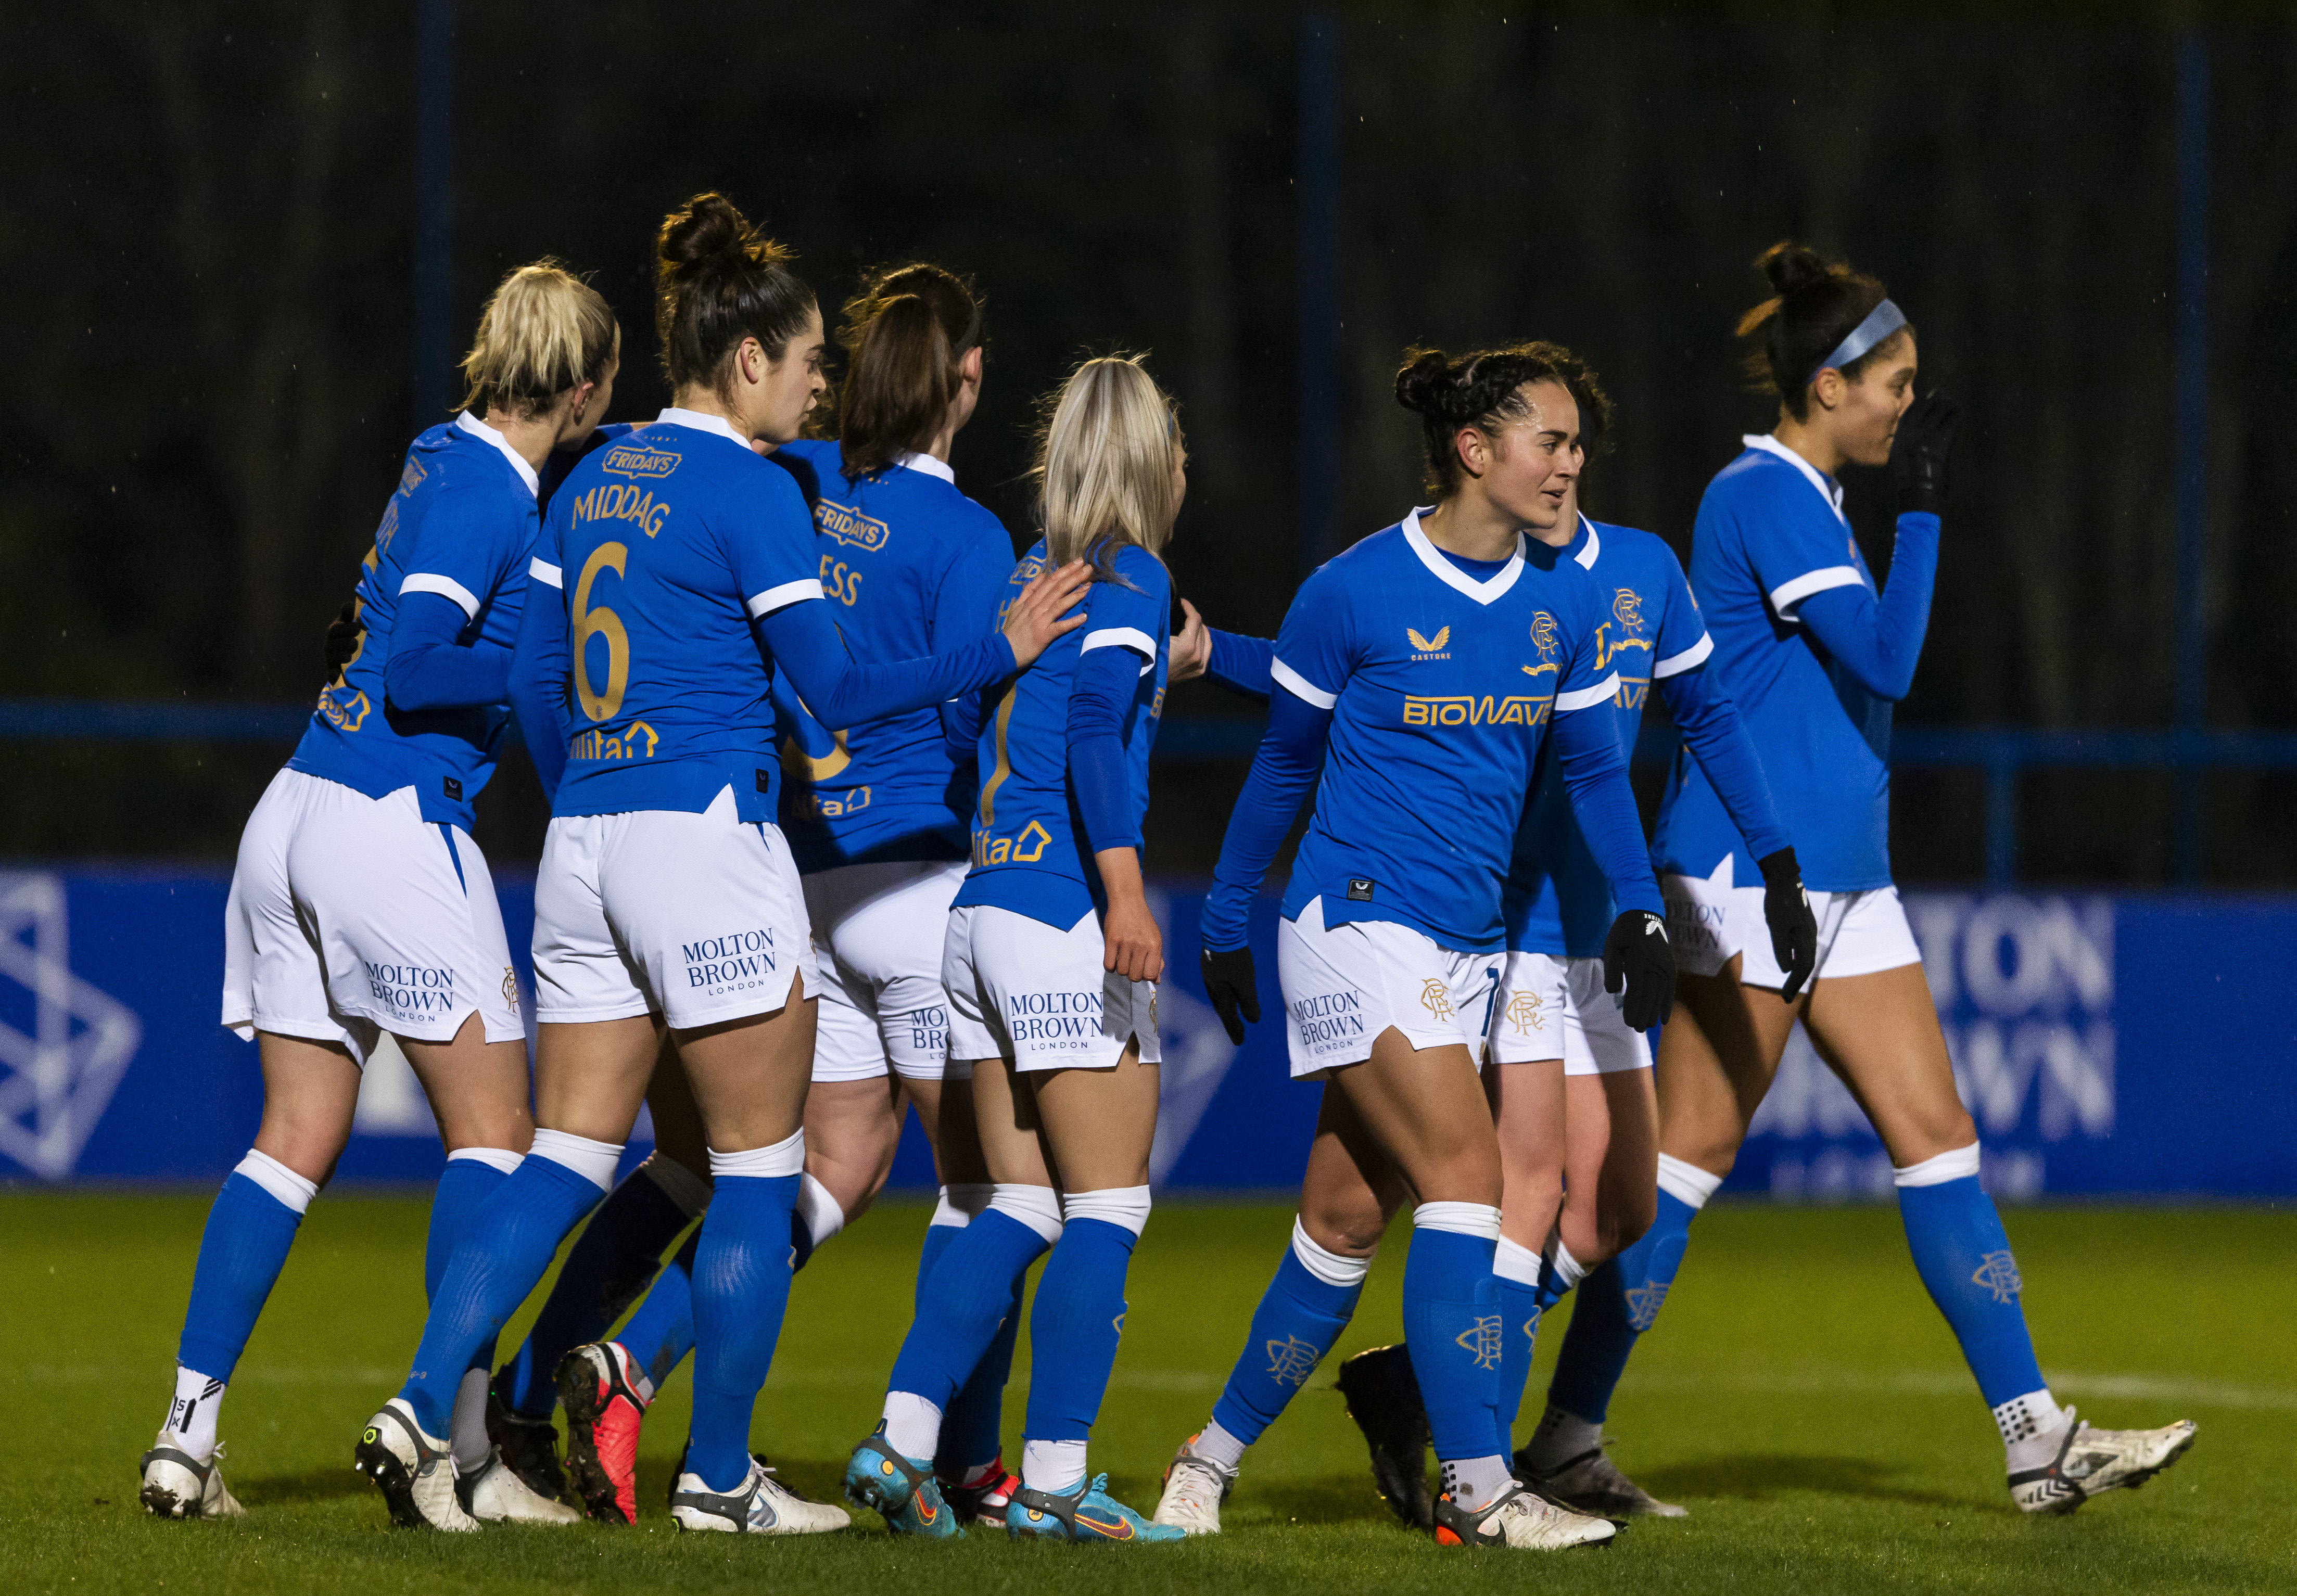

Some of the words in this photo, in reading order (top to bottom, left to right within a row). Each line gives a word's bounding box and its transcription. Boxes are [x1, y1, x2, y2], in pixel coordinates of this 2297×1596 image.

[606, 451, 673, 471] FRIDAYS
[572, 484, 671, 539] MIDDAG
[813, 504, 880, 544] FRIDAYS
[819, 554, 862, 606] ESS
[573, 541, 630, 722] 6
[1411, 653, 1451, 661] CASTORE
[681, 927, 775, 964] MOLTON
[364, 961, 454, 988] MOLTON
[686, 951, 776, 988] BROWN
[370, 981, 454, 1012] BROWN
[708, 979, 764, 996] LONDON
[385, 1005, 436, 1022] LONDON
[1009, 991, 1103, 1017] MOLTON
[1293, 990, 1360, 1023] MOLTON
[1011, 1016, 1104, 1042] BROWN
[1300, 1013, 1364, 1045] BROWN
[1031, 1041, 1088, 1051] LONDON
[1315, 1040, 1353, 1054] LONDON
